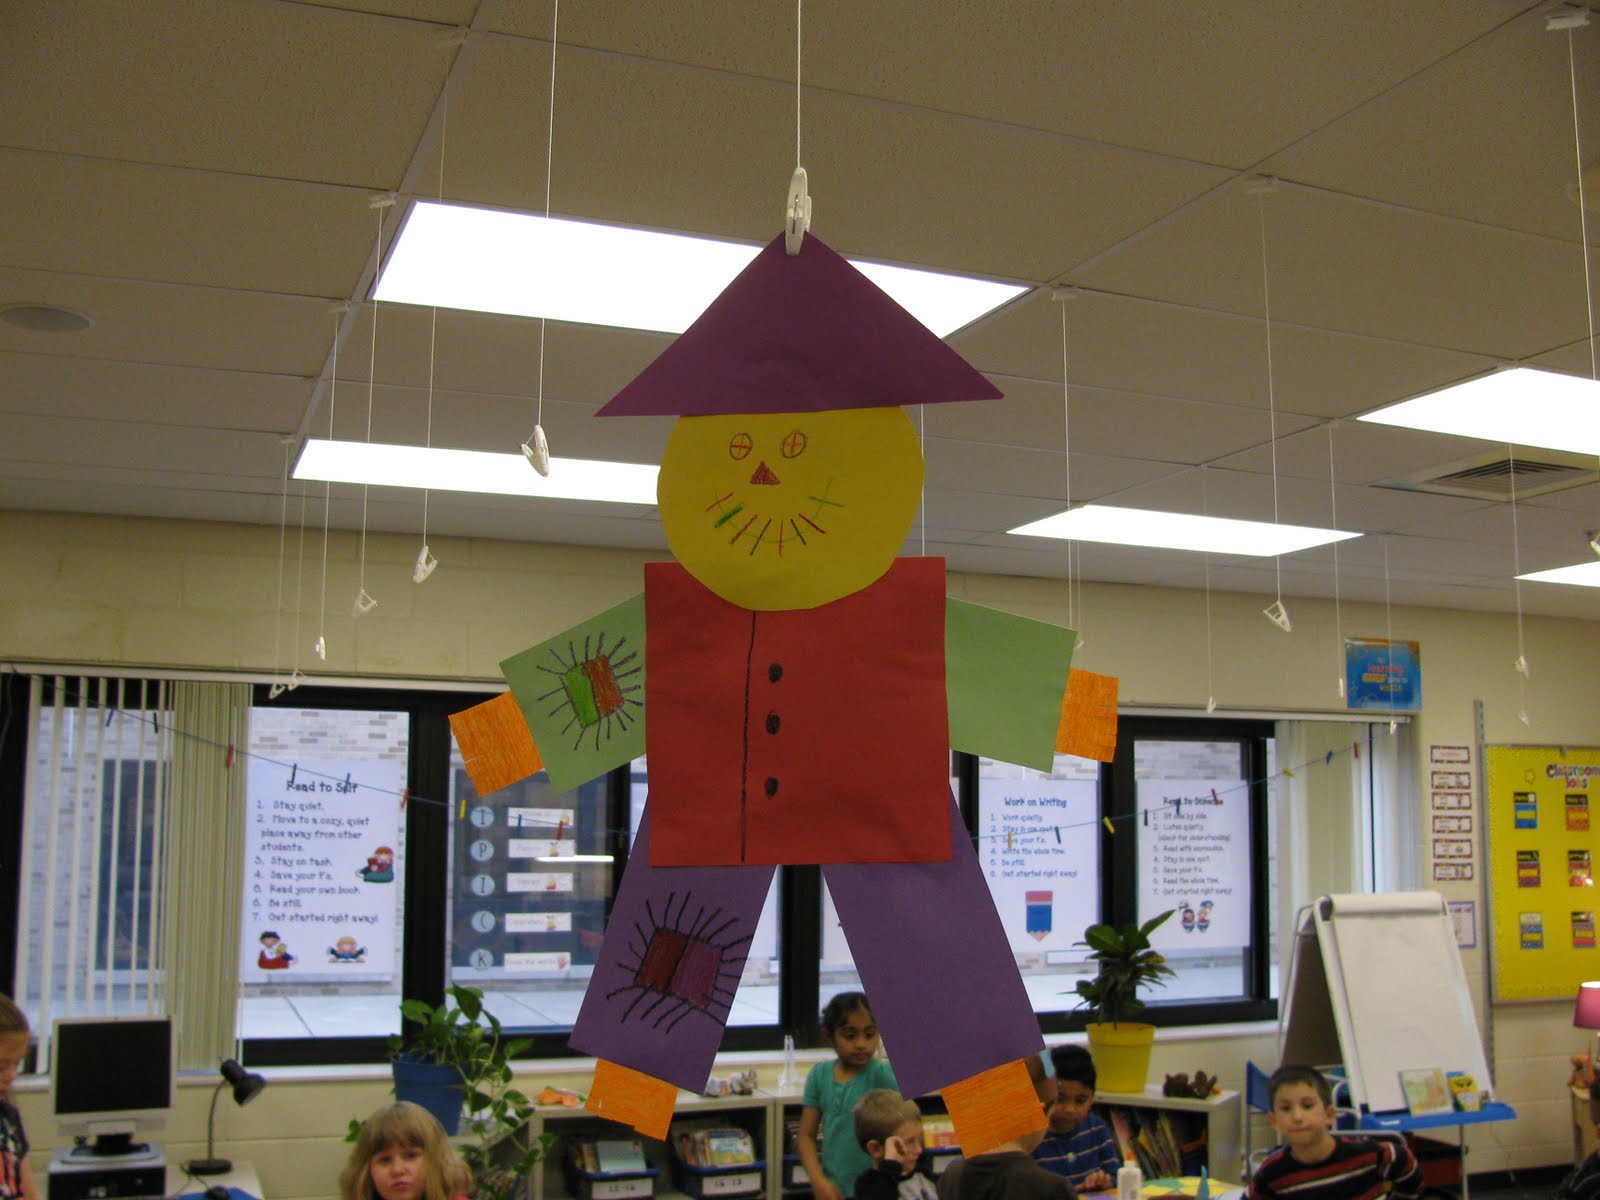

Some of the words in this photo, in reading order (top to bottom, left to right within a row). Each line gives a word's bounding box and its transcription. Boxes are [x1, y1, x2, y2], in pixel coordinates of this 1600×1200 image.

[286, 780, 315, 791] Read
[320, 782, 332, 792] to
[274, 801, 296, 811] Stay
[1005, 797, 1025, 806] Work
[1040, 797, 1067, 808] Writing
[1163, 797, 1181, 805] Rea
[272, 815, 296, 823] Move
[300, 816, 309, 824] to
[347, 818, 369, 826] quiet
[261, 829, 285, 838] place
[288, 831, 312, 839] away
[271, 857, 294, 866] Stay
[295, 872, 316, 880] your
[270, 884, 292, 893] Read
[295, 886, 316, 895] your
[289, 913, 325, 922] started
